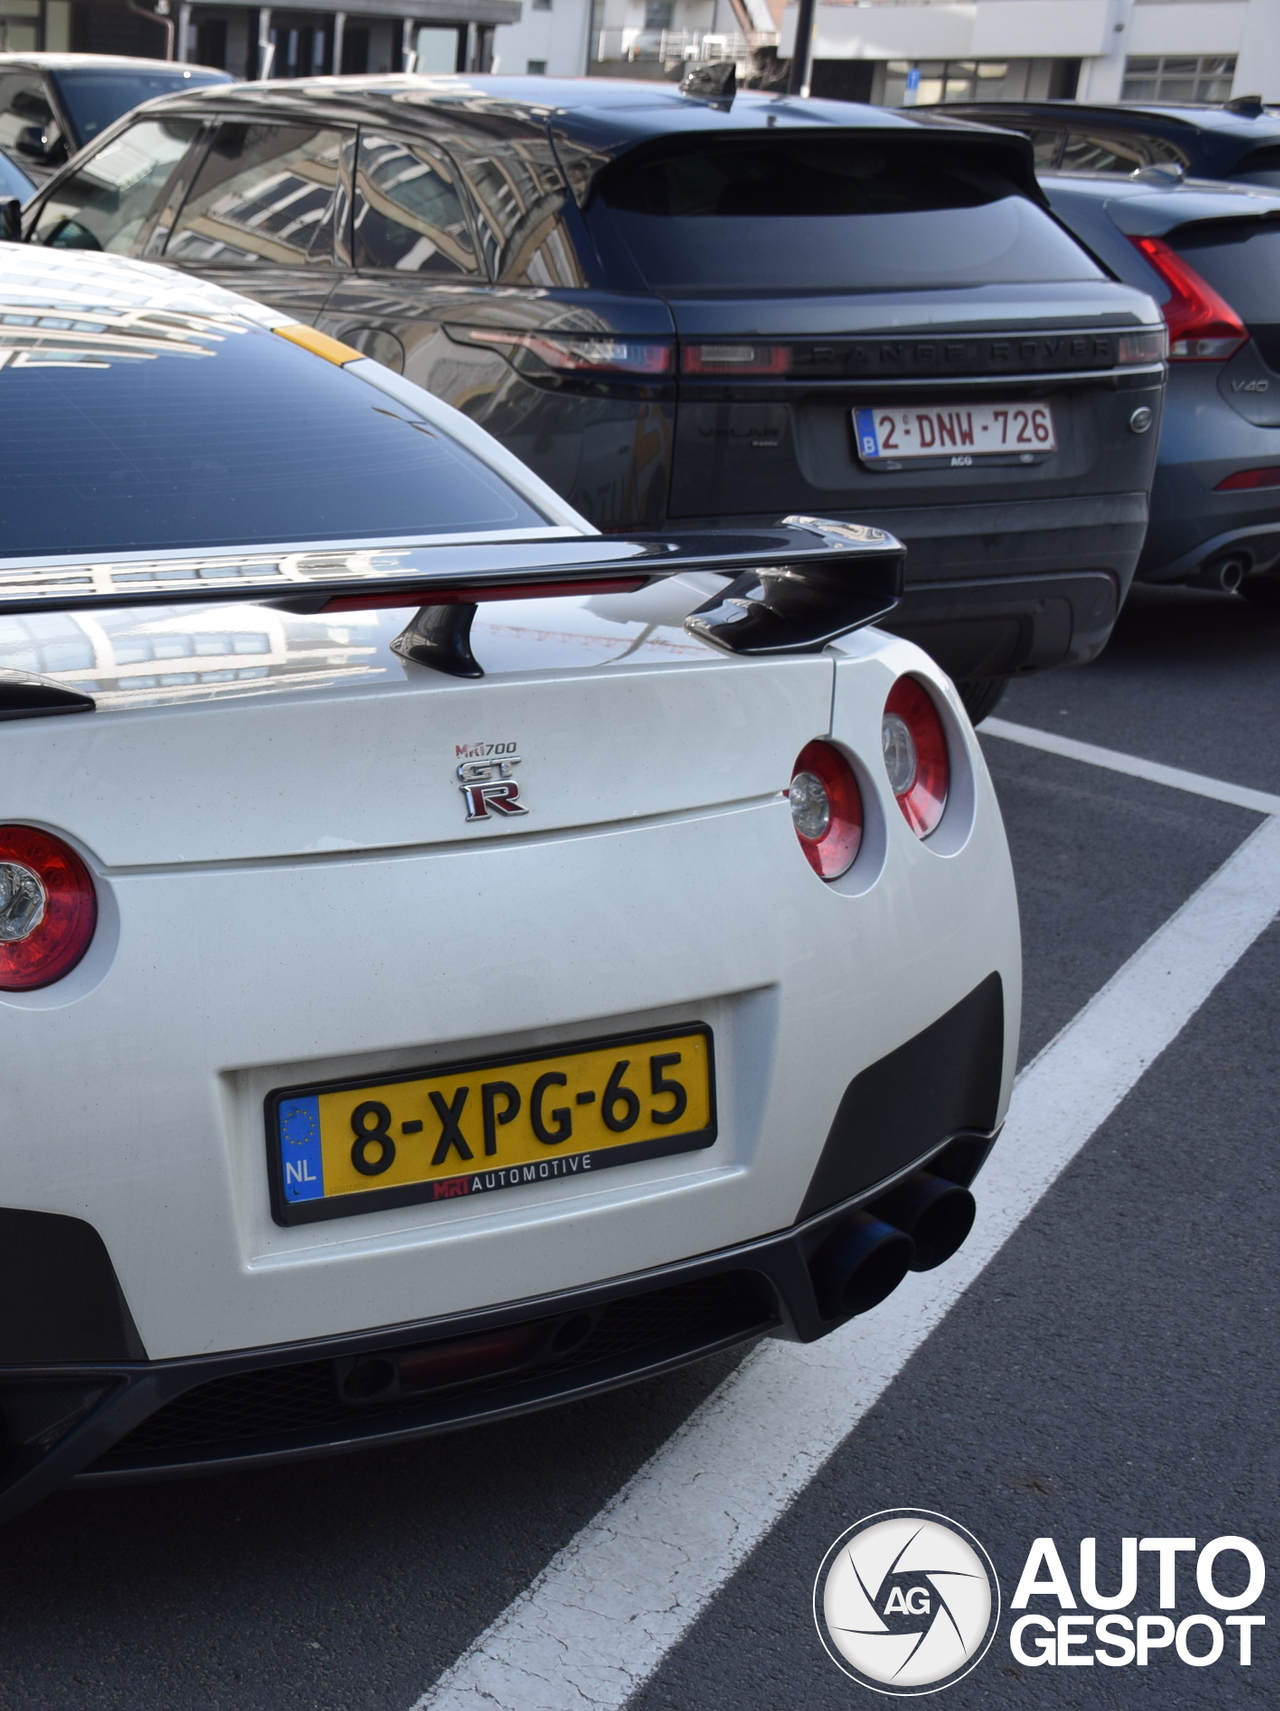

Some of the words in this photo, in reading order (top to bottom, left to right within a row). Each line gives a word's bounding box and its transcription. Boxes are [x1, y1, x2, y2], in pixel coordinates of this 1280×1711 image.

[811, 345, 966, 364] RANGE
[990, 338, 1111, 361] ROVER
[1231, 379, 1269, 392] V40
[863, 437, 876, 453] B
[350, 1052, 688, 1176] 8-XPG-65
[285, 1159, 317, 1185] NL
[471, 1154, 592, 1192] AUTOMOTIVE
